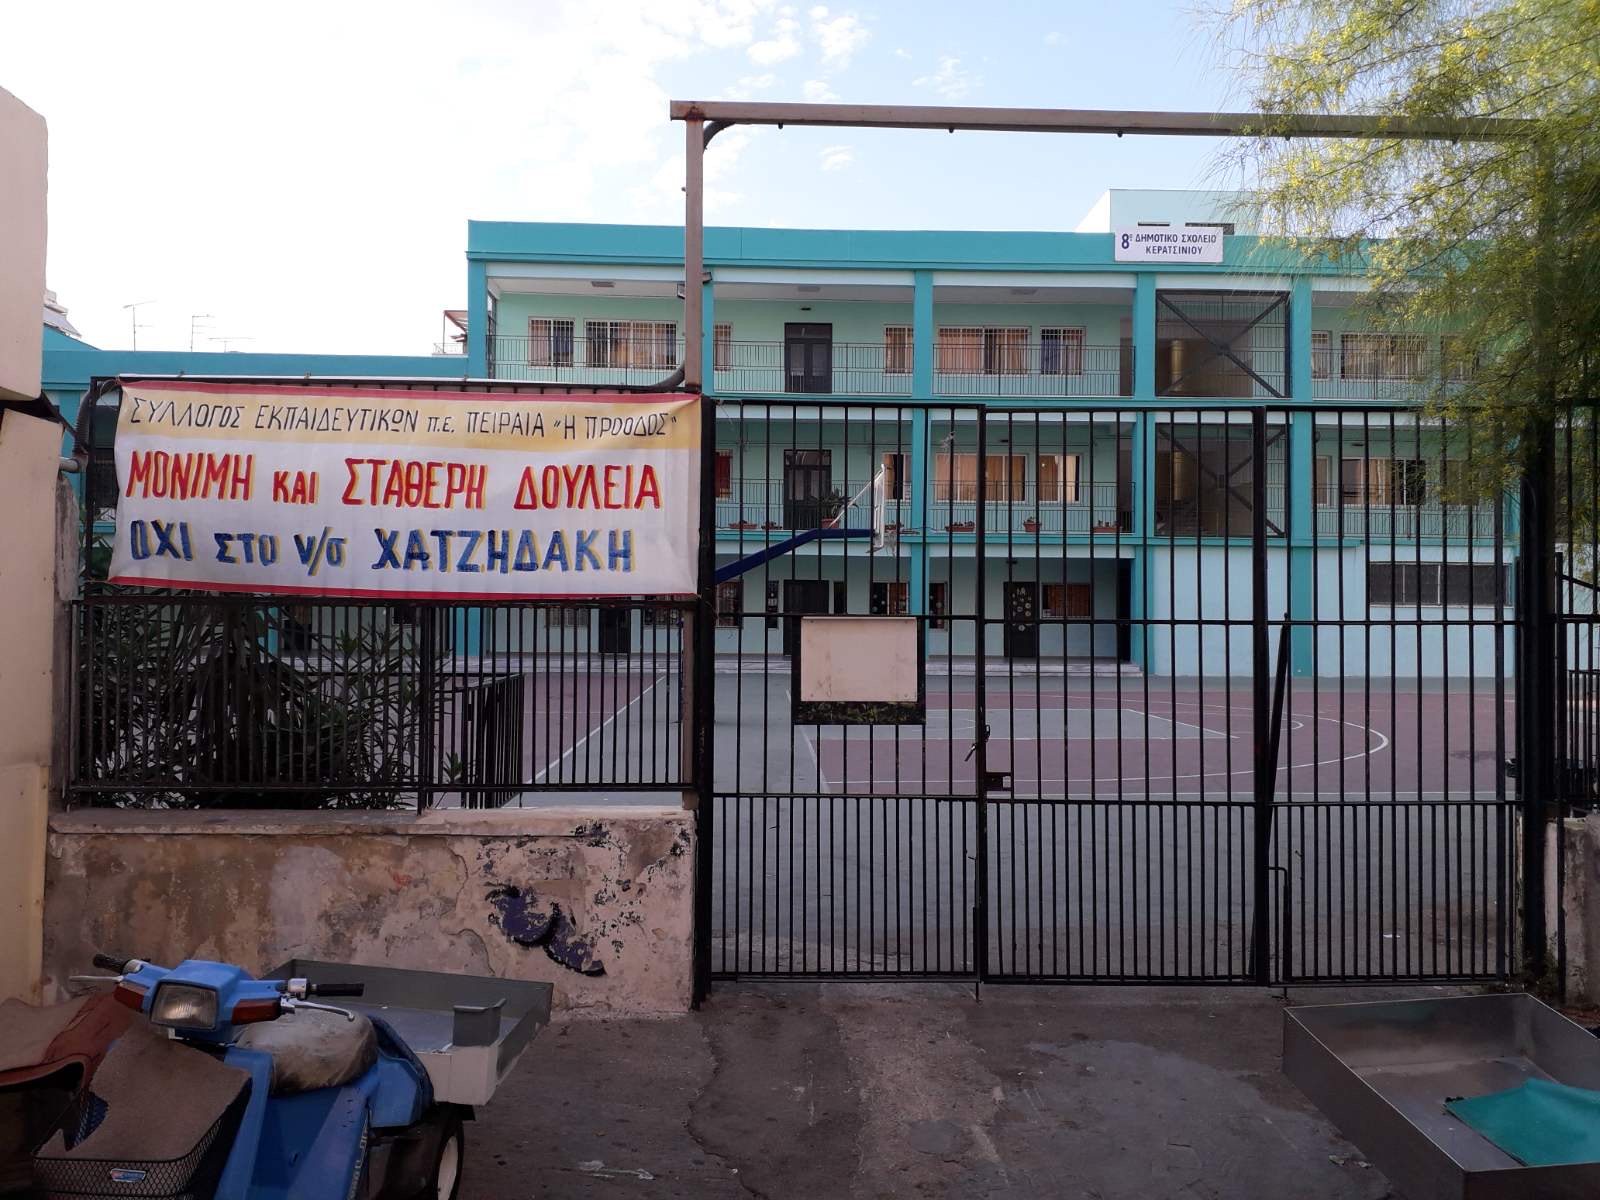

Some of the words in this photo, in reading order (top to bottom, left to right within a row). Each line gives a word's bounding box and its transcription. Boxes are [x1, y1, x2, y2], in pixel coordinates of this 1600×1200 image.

[1135, 233, 1178, 243] ΔΗΜΟΤΙΚΟ
[1181, 234, 1217, 243] ΣΧΟΛΕΙΟ
[1145, 245, 1203, 255] ΚΕΡΑΤΣΙΝΙΟΥ
[130, 396, 245, 429] ΣΥΛΛΟΓΟΣ
[254, 404, 418, 433] ΕΚΠΑΙΔΕΥΤΙΚΩΝ
[467, 411, 545, 438] ΠΕΙΡΑΙΑ
[126, 450, 257, 501] ΜΟΝΙΜΗ
[273, 470, 319, 505] ΚΑΙ
[341, 457, 488, 510] ΣΤΑΘΕΡΗ
[513, 464, 664, 511] ΔΟΥΛΕΙΑ
[130, 519, 196, 562] ΟΧΙ
[213, 531, 281, 567] ΣΤΟ
[371, 527, 636, 575] ΧΑΤΖΗΔΑΚΗ
